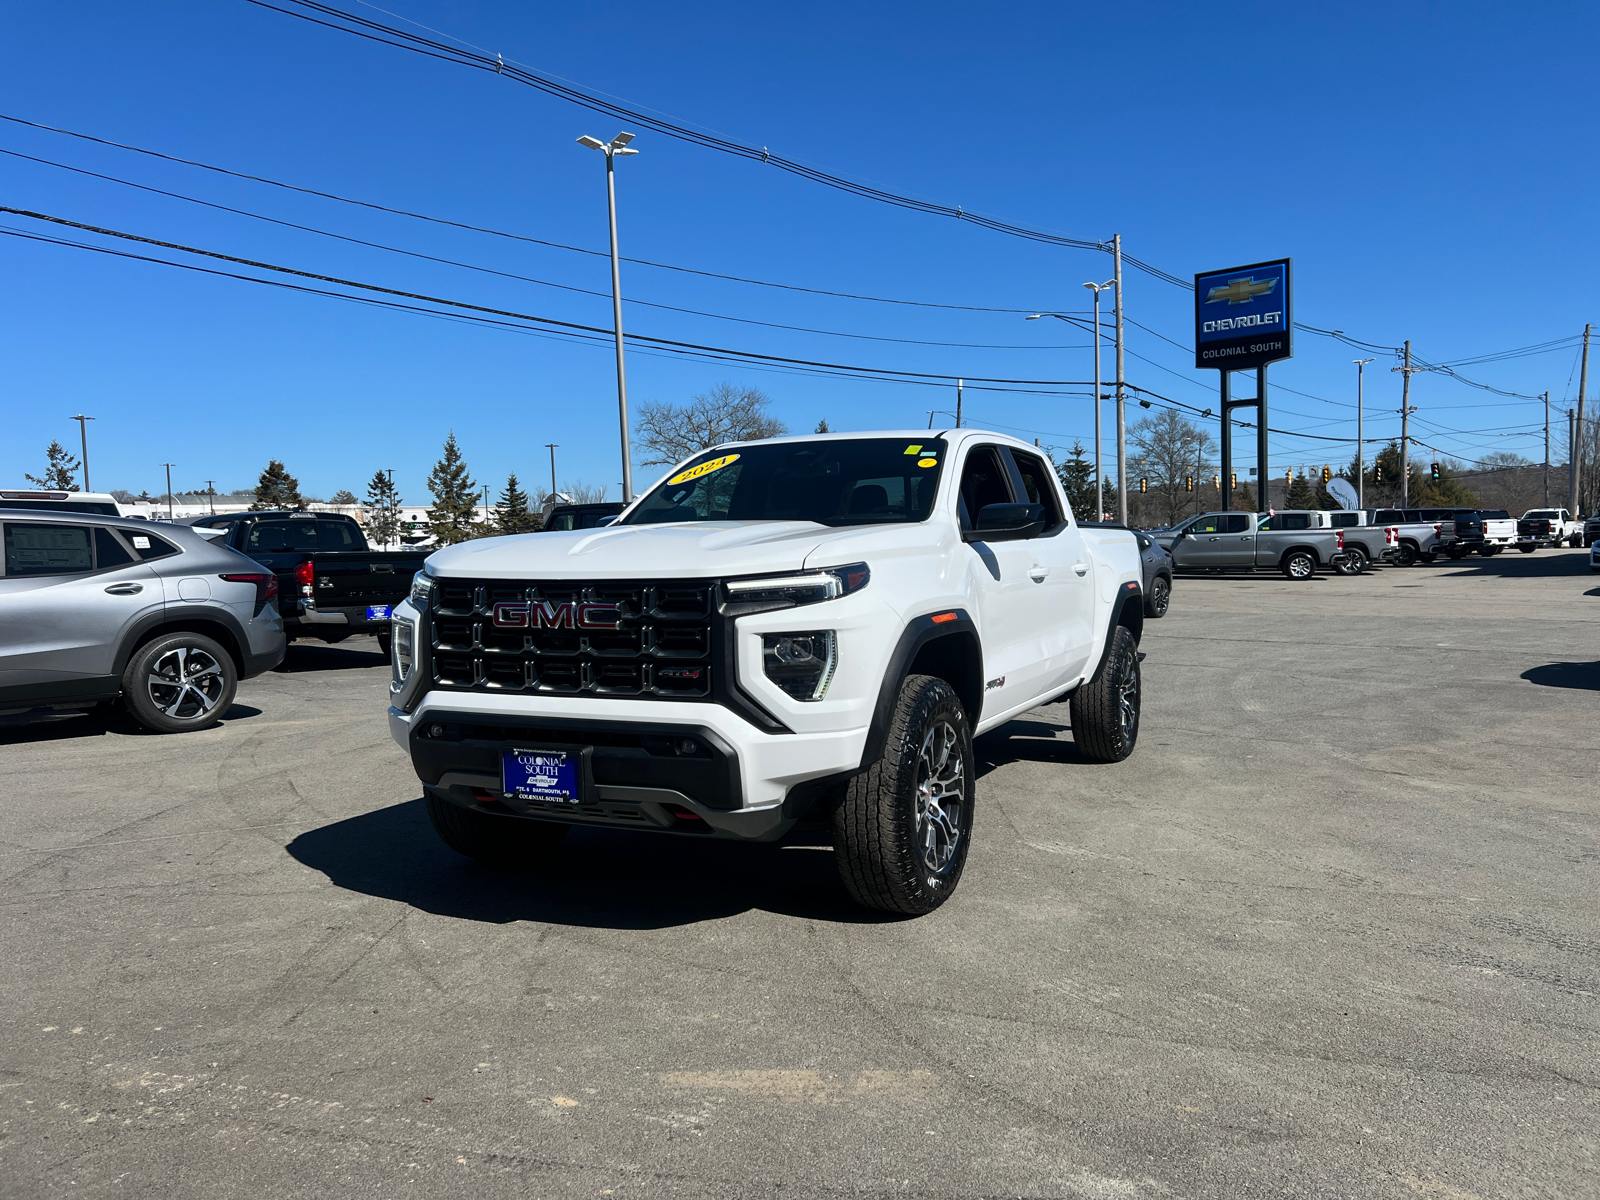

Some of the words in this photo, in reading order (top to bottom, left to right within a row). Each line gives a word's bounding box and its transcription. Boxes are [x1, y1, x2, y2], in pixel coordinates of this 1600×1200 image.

[1203, 311, 1281, 333] CHEVROLET
[1202, 346, 1247, 359] COLONIAL
[1250, 341, 1282, 353] SOUTH
[681, 457, 727, 481] 2024
[493, 602, 622, 629] GMC
[518, 755, 566, 767] COLONIAL
[525, 765, 559, 776] SOUTH
[529, 777, 556, 785] CHEVROLET
[545, 795, 564, 803] SOUTH
